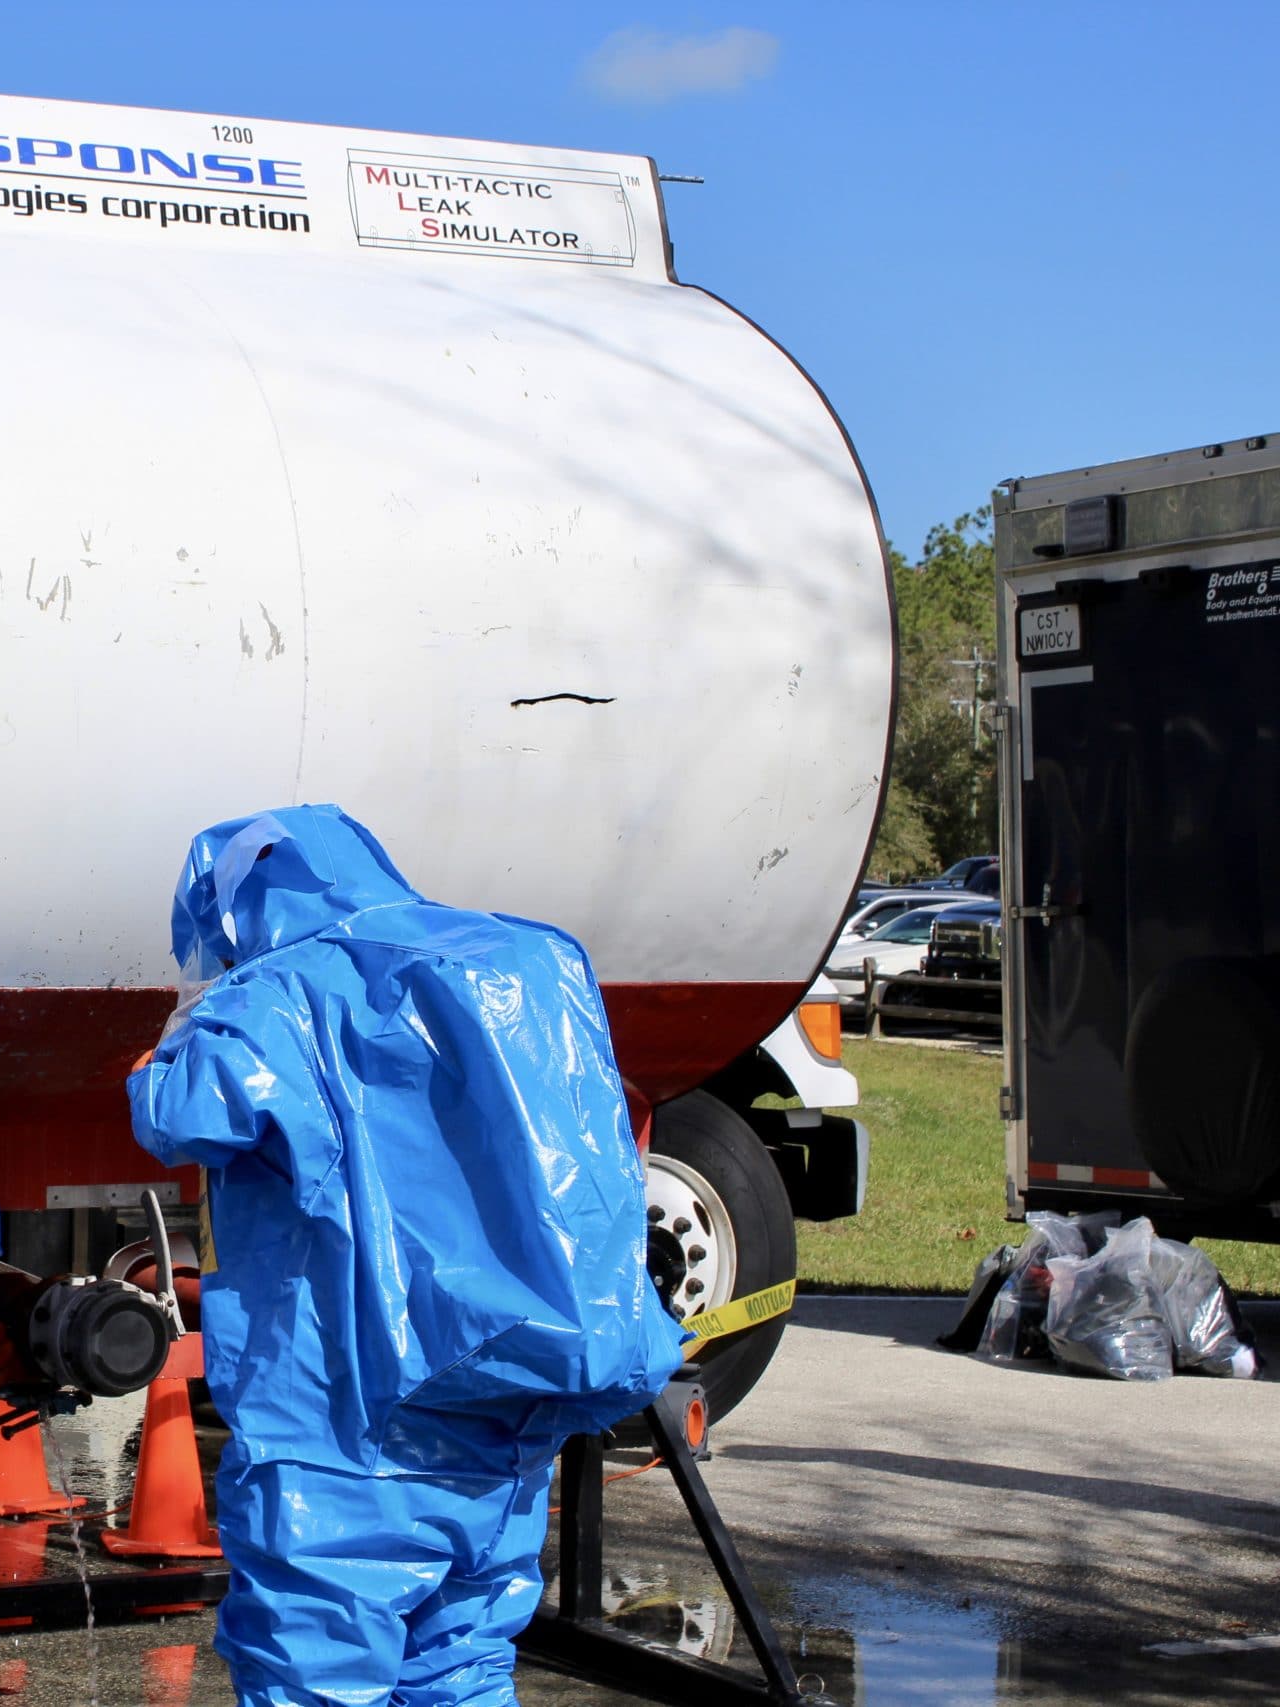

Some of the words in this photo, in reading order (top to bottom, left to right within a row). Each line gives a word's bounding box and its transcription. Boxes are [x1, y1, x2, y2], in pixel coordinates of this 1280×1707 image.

[211, 125, 253, 145] 1200
[365, 166, 553, 199] MULTI-TACTIC
[101, 196, 311, 233] corporation
[397, 191, 473, 217] LEAK
[421, 218, 580, 249] SIMULATOR
[1208, 570, 1268, 589] Brothers
[1205, 600, 1228, 610] Body
[1229, 597, 1247, 607] and
[1037, 611, 1060, 630] CST
